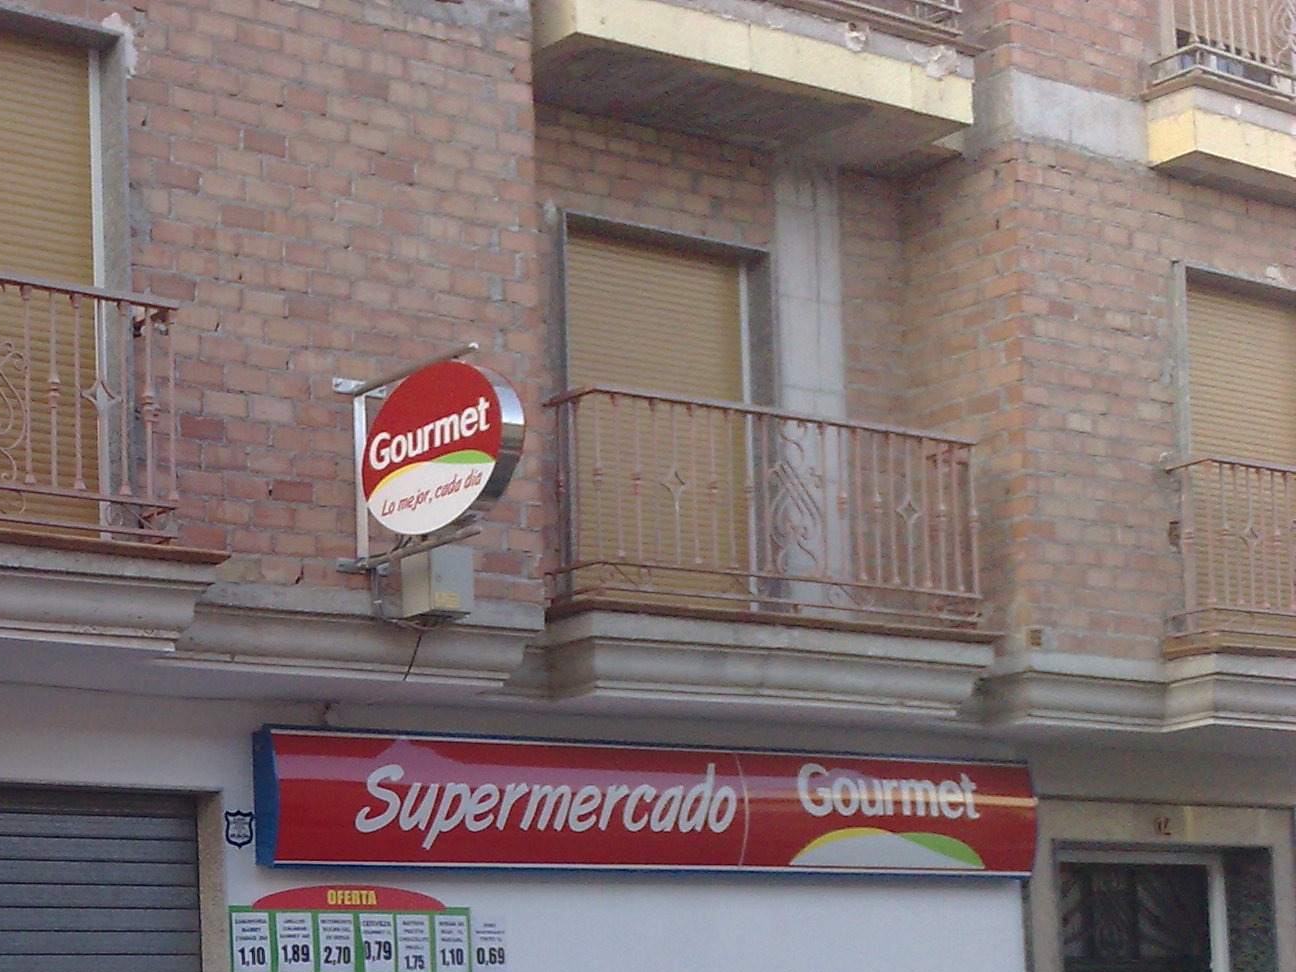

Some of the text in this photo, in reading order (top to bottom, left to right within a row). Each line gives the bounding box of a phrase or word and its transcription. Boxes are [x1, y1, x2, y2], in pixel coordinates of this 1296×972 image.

[369, 396, 490, 470] Gourmet
[381, 499, 395, 516] Lo
[435, 473, 462, 499] cada
[355, 762, 980, 850] Supermercado Gourmet
[327, 889, 377, 905] OFERTA
[238, 946, 266, 966] 1,10
[281, 944, 310, 964] 1,89
[324, 945, 351, 965] 2,70
[405, 954, 425, 970] 1,75
[440, 947, 464, 966] 1,10
[476, 947, 505, 965] 0,69
